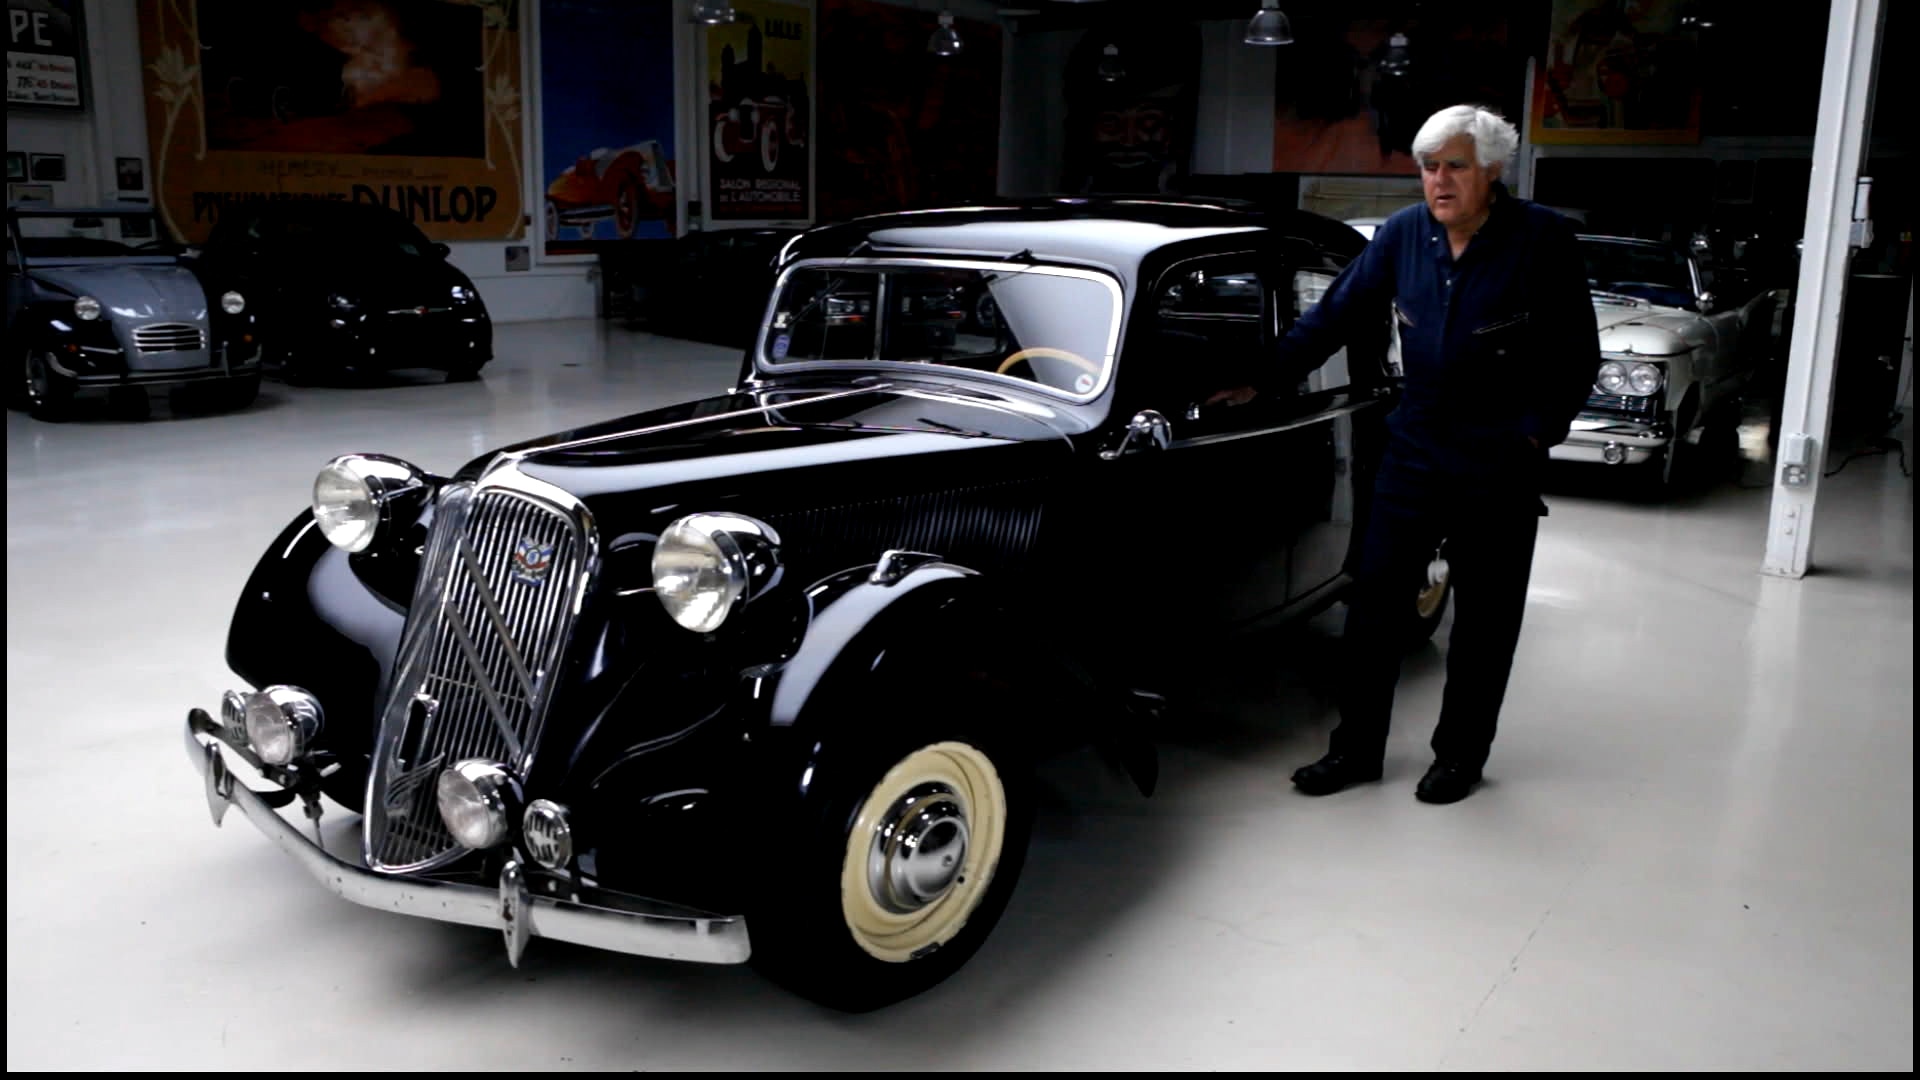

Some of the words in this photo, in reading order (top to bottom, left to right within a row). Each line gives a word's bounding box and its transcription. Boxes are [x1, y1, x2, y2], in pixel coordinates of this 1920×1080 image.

[766, 18, 802, 41] LILLE
[719, 177, 752, 191] SALON
[352, 184, 497, 223] DUNLOP
